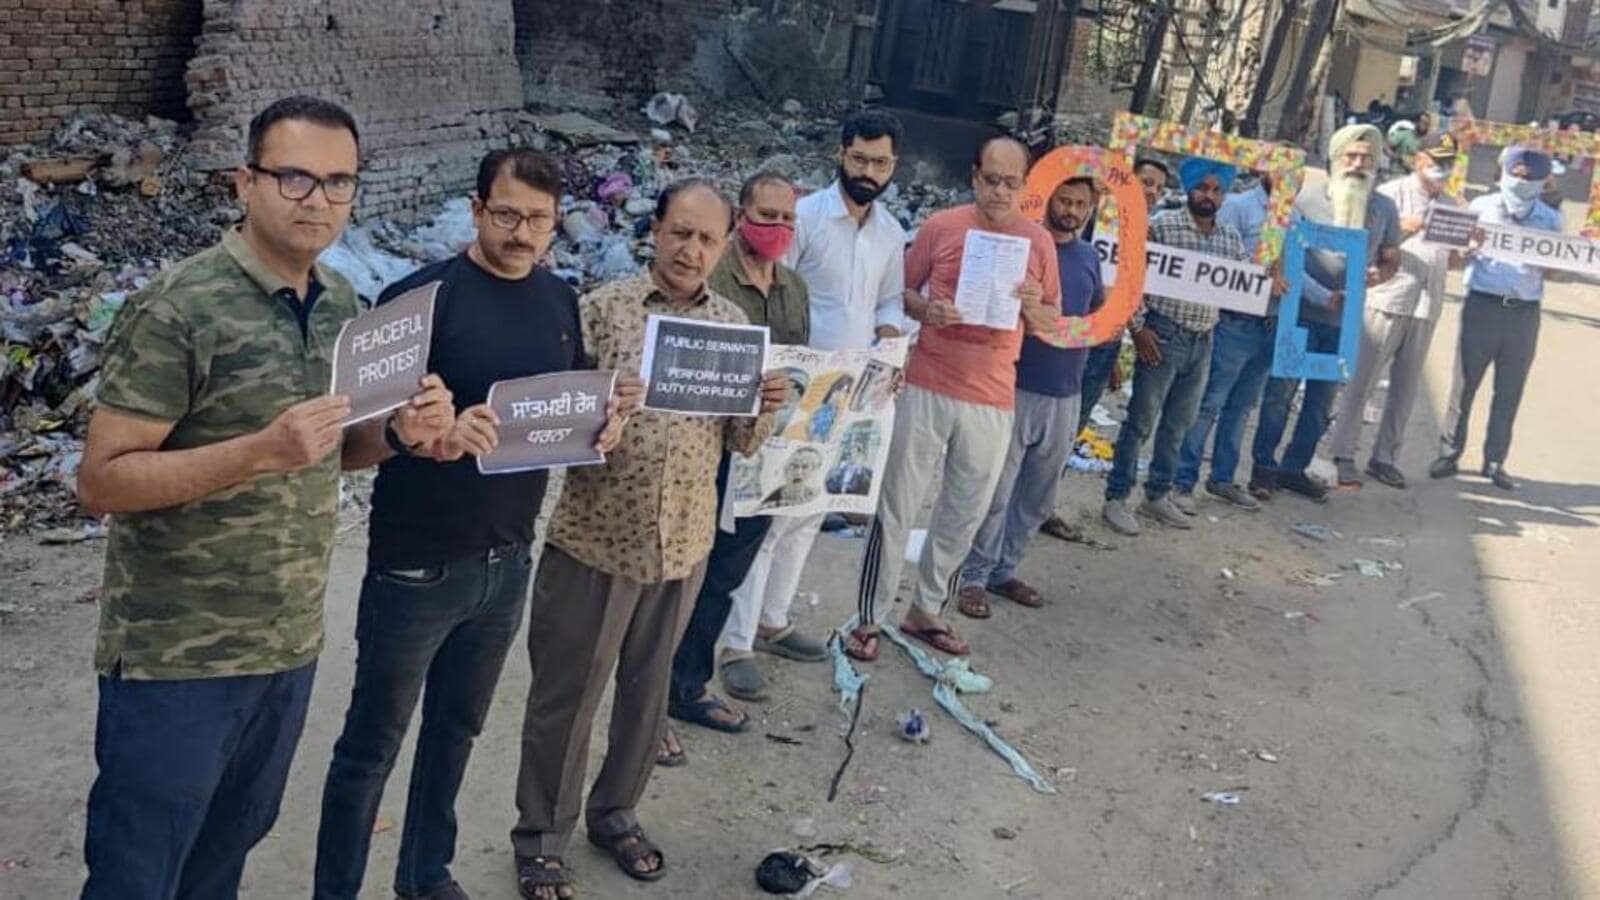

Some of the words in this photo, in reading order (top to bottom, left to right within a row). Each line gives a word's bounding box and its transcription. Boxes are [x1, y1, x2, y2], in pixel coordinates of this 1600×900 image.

[1521, 236, 1599, 263] POINT
[1093, 239, 1185, 279] SEFIE
[1194, 261, 1268, 295] POINT
[352, 314, 423, 355] PEACEFUL
[664, 335, 705, 350] PUBLIC
[706, 341, 759, 354] SERVANTS
[358, 344, 421, 387] PROTEST
[656, 382, 685, 394] DUTY
[686, 384, 709, 396] FOR
